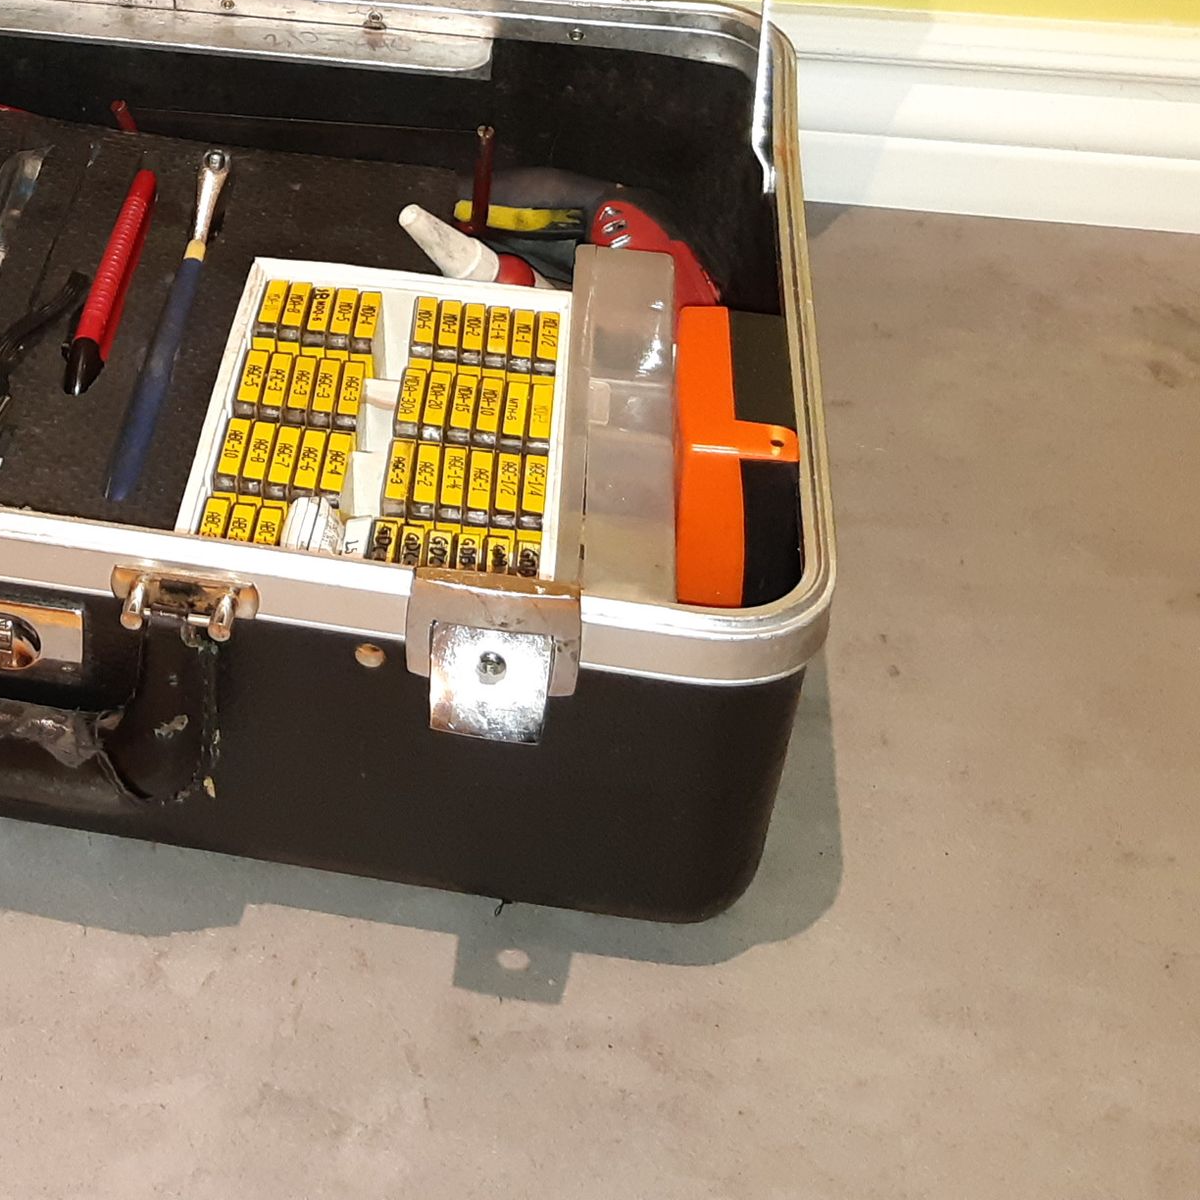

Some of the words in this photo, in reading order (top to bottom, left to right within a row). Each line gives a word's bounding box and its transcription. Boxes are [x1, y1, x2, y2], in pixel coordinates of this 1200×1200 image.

[342, 375, 360, 402] AGC-3
[400, 374, 420, 415] MDA-30A
[427, 382, 446, 410] MDA-20
[455, 385, 473, 413] MDA-15
[480, 388, 498, 416] MDA-10
[416, 461, 435, 487] AGC-2
[471, 468, 490, 493] AGC-1
[500, 461, 518, 496] AGC-1/2
